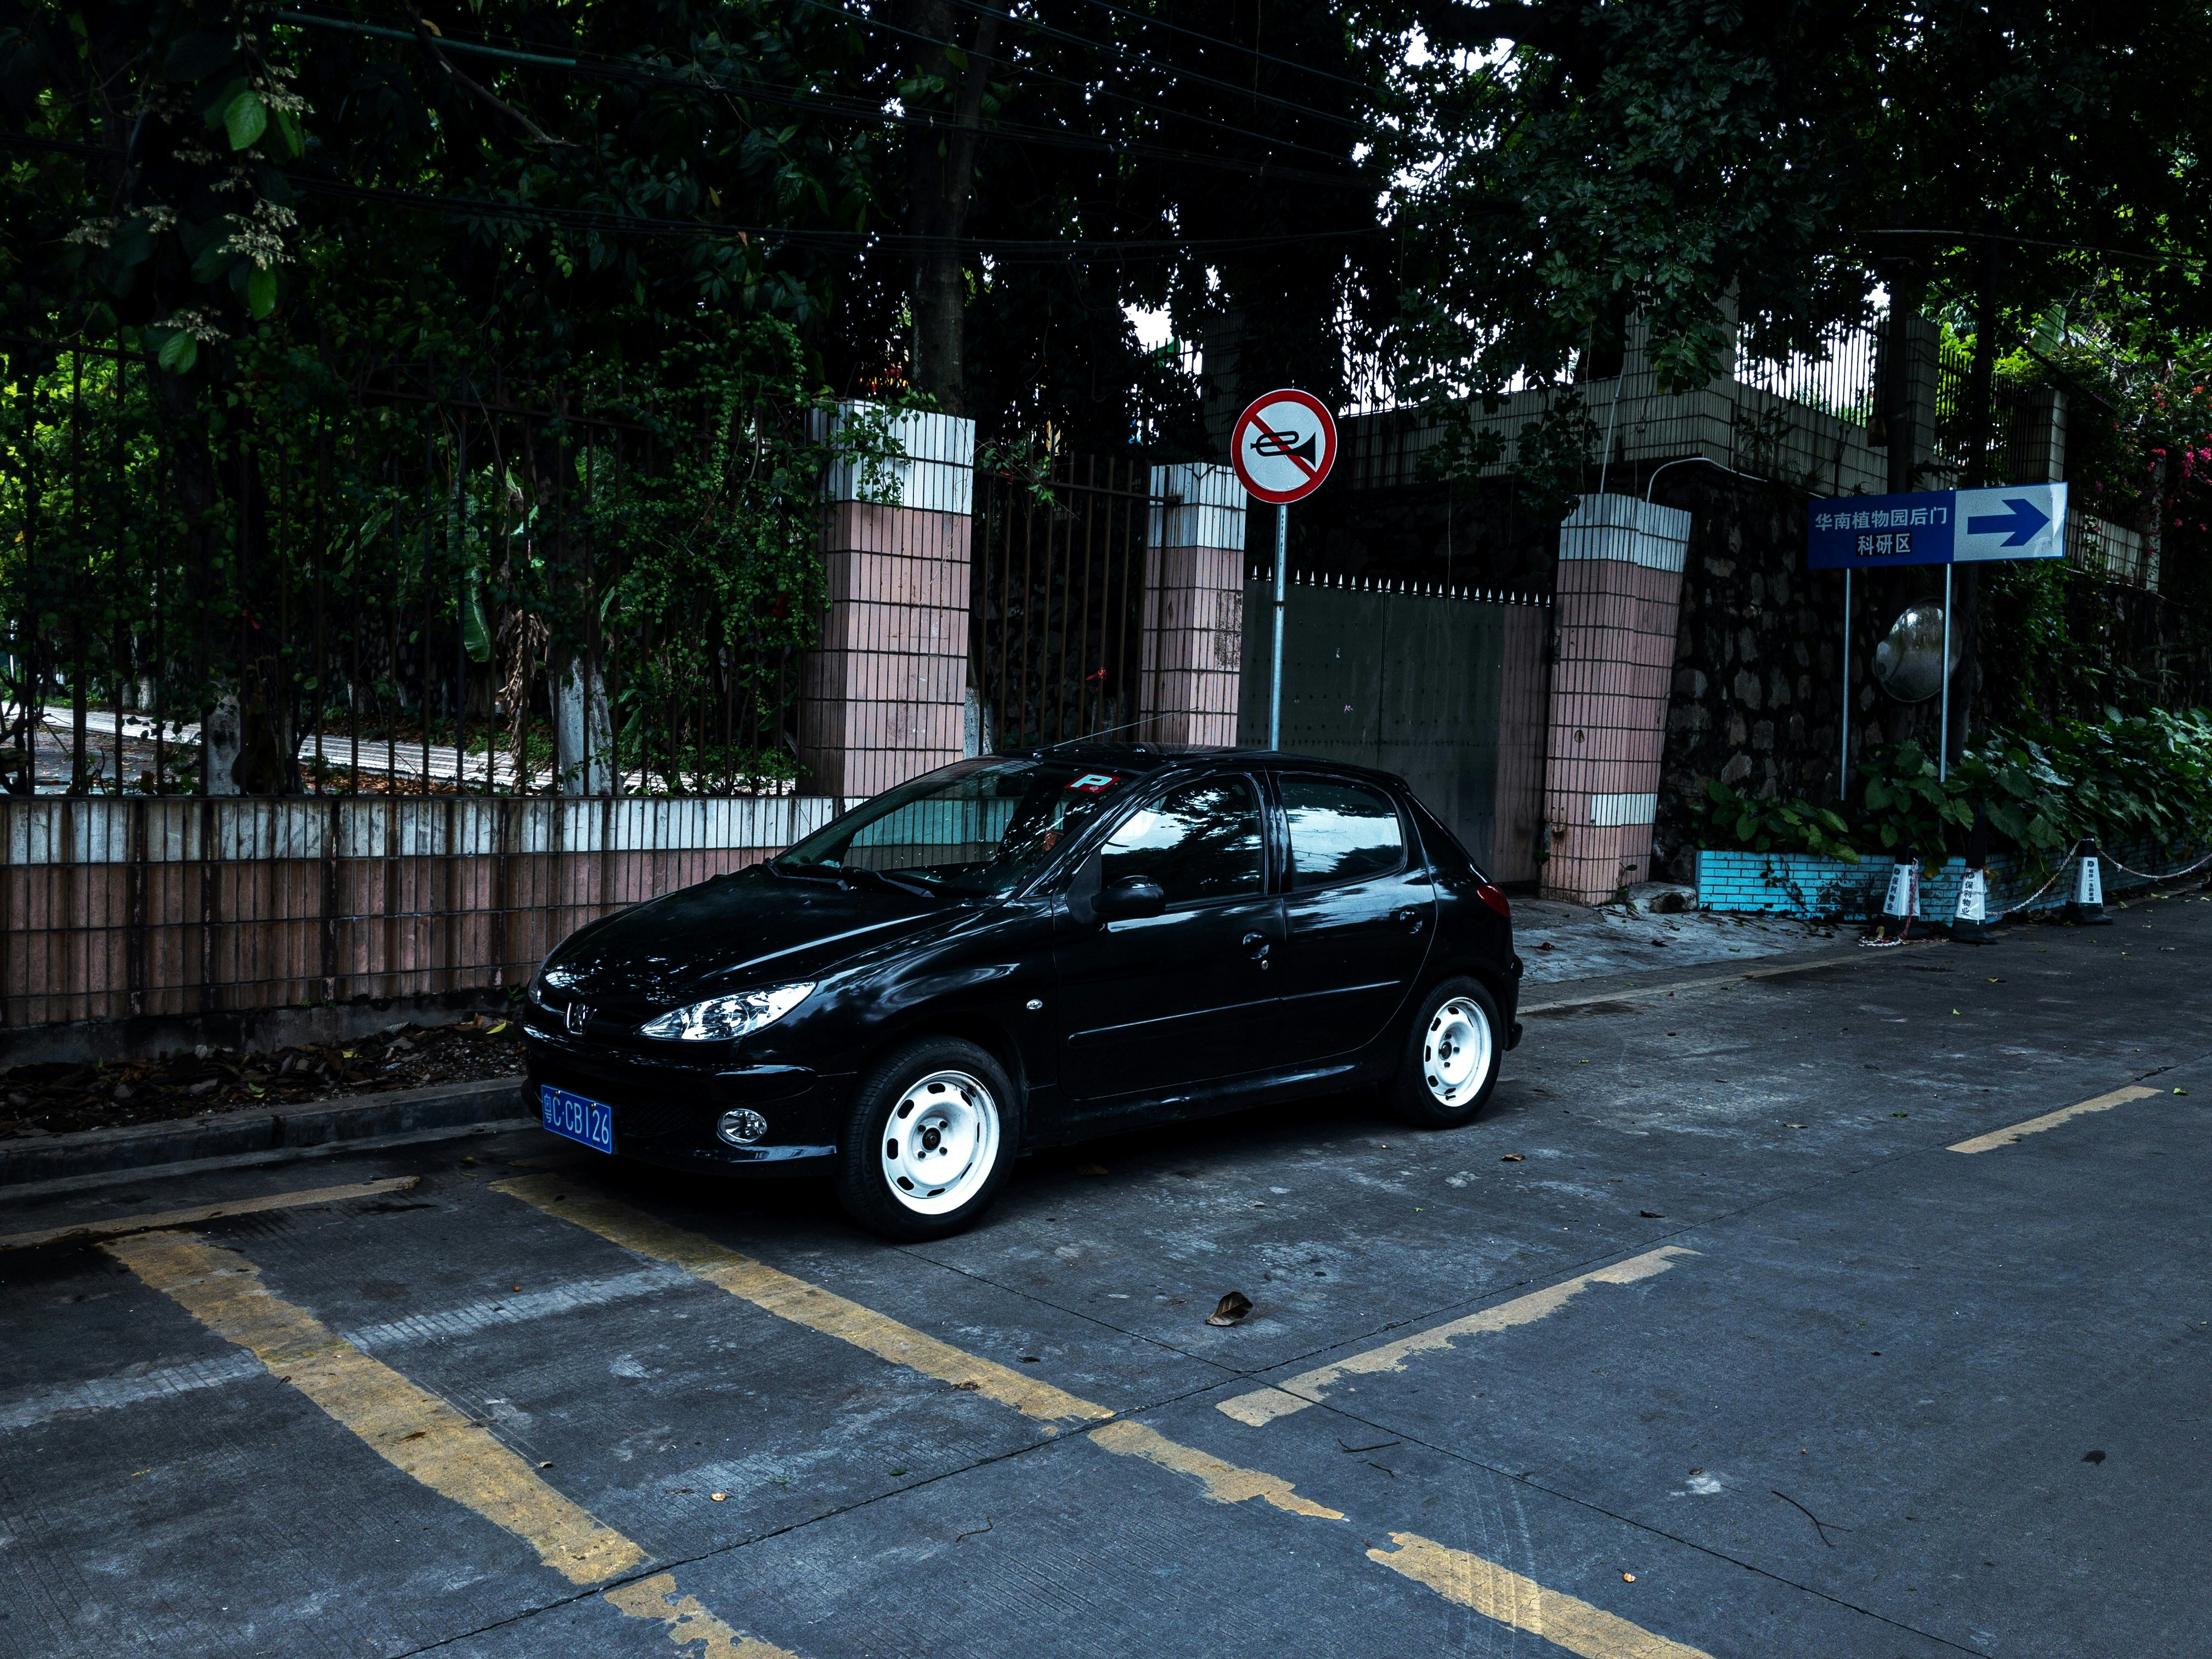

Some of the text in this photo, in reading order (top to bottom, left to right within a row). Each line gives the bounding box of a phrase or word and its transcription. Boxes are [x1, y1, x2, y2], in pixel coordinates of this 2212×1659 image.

[1815, 506, 1948, 531] 华南植物园后门
[1857, 533, 1911, 556] 科研区
[1886, 877, 1899, 911] 保利物业
[1961, 881, 1974, 916] 保利物业
